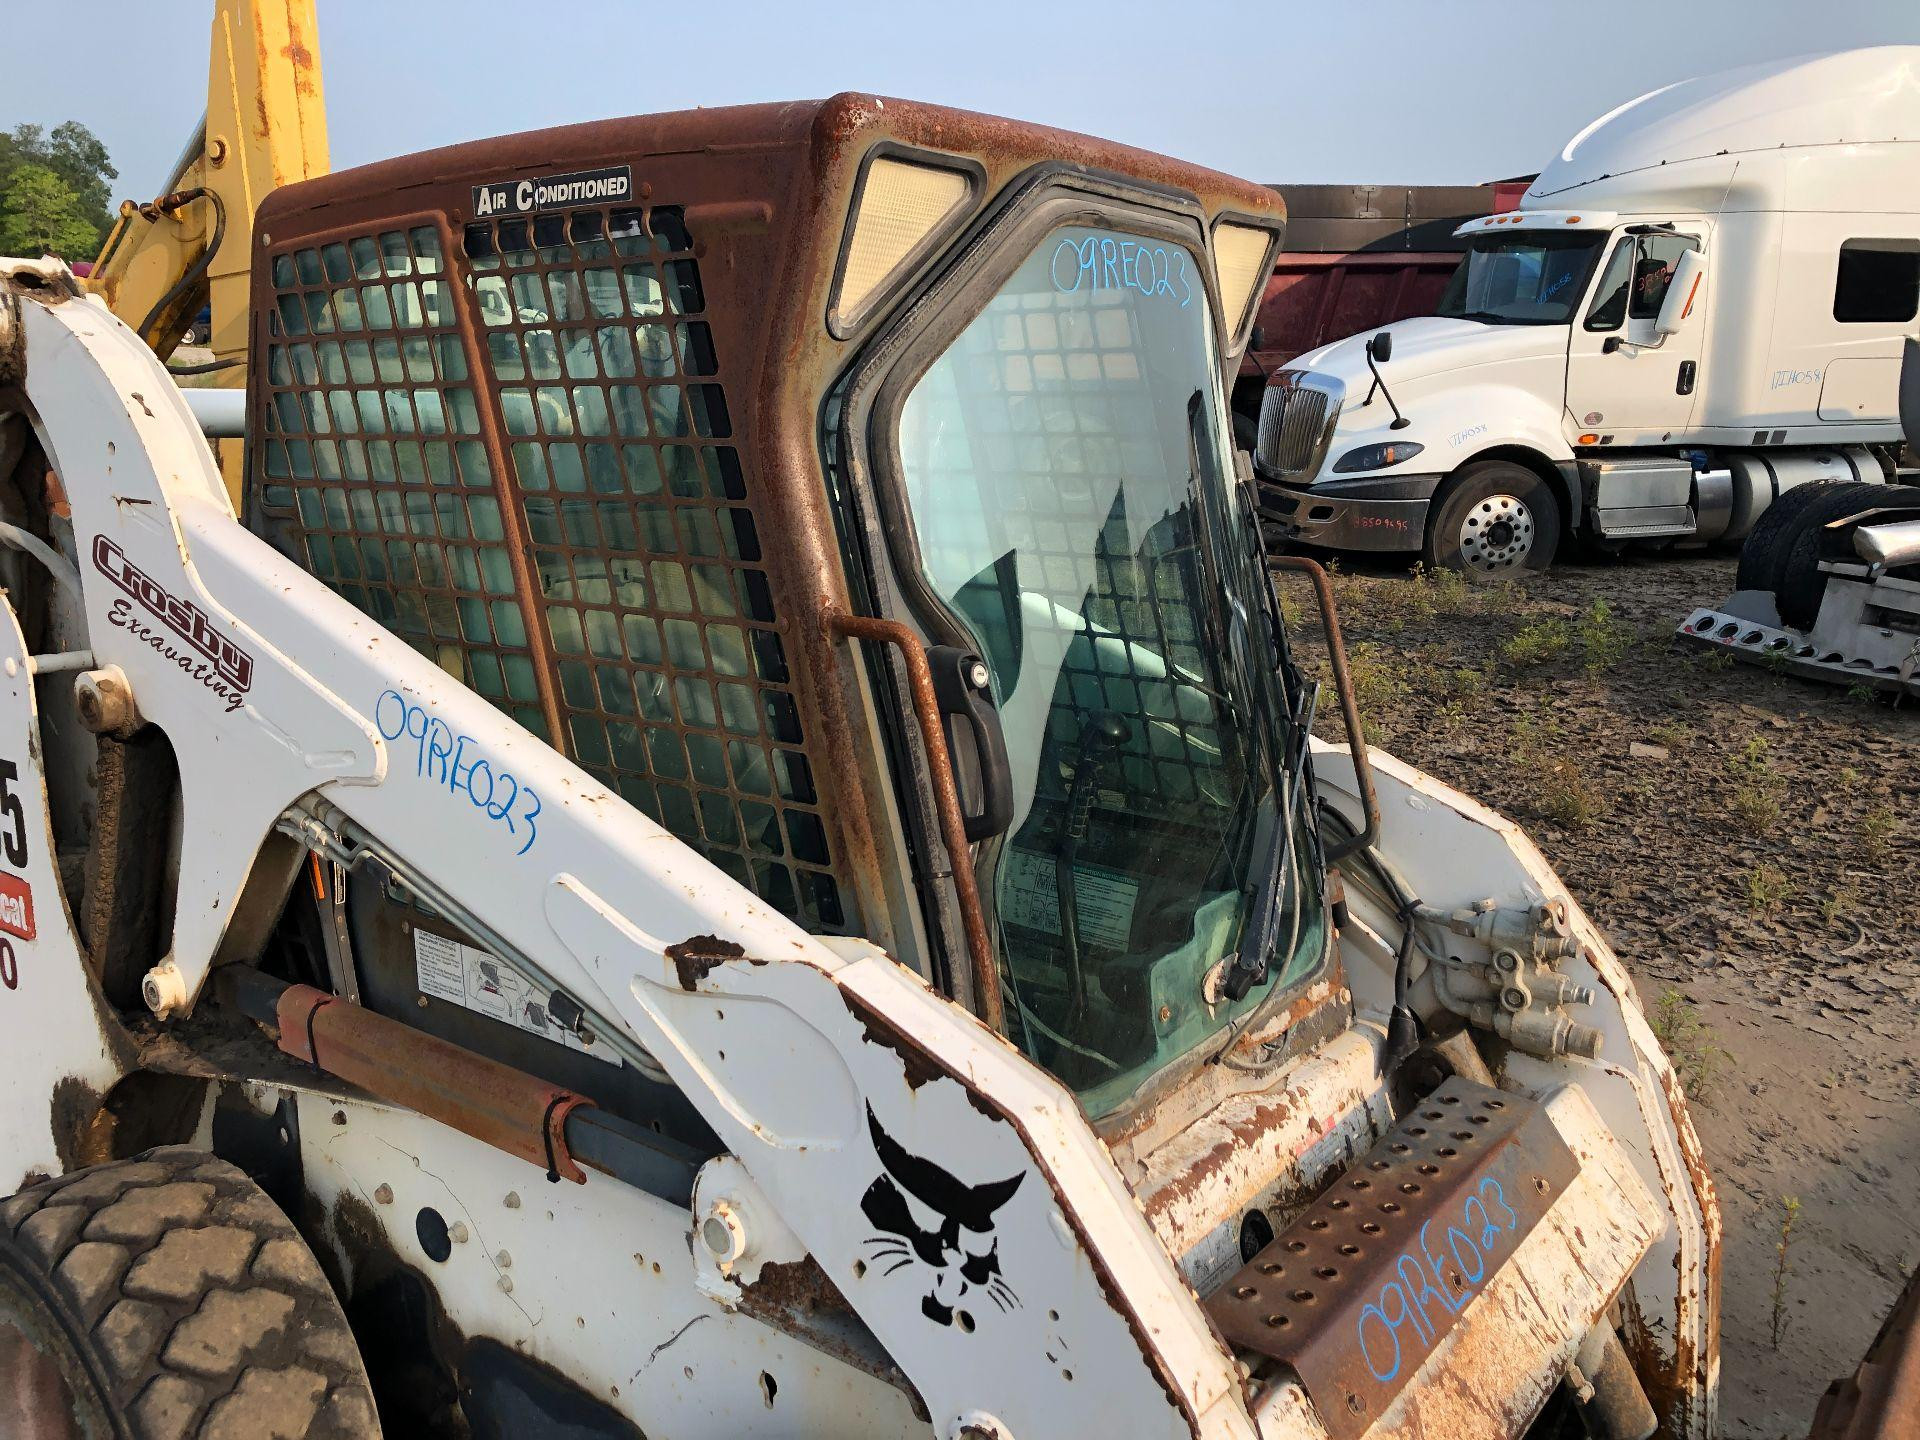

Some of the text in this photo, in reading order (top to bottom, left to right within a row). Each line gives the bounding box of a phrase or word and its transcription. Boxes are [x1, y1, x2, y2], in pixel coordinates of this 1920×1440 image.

[1052, 236, 1191, 310] 09RE023
[1770, 368, 1821, 390] 17IH058
[92, 533, 254, 693] Crosby
[107, 598, 245, 713] Excavating
[0, 758, 28, 869] 5
[375, 689, 542, 856] 09RE023
[1358, 1175, 1517, 1382] 09RE023
